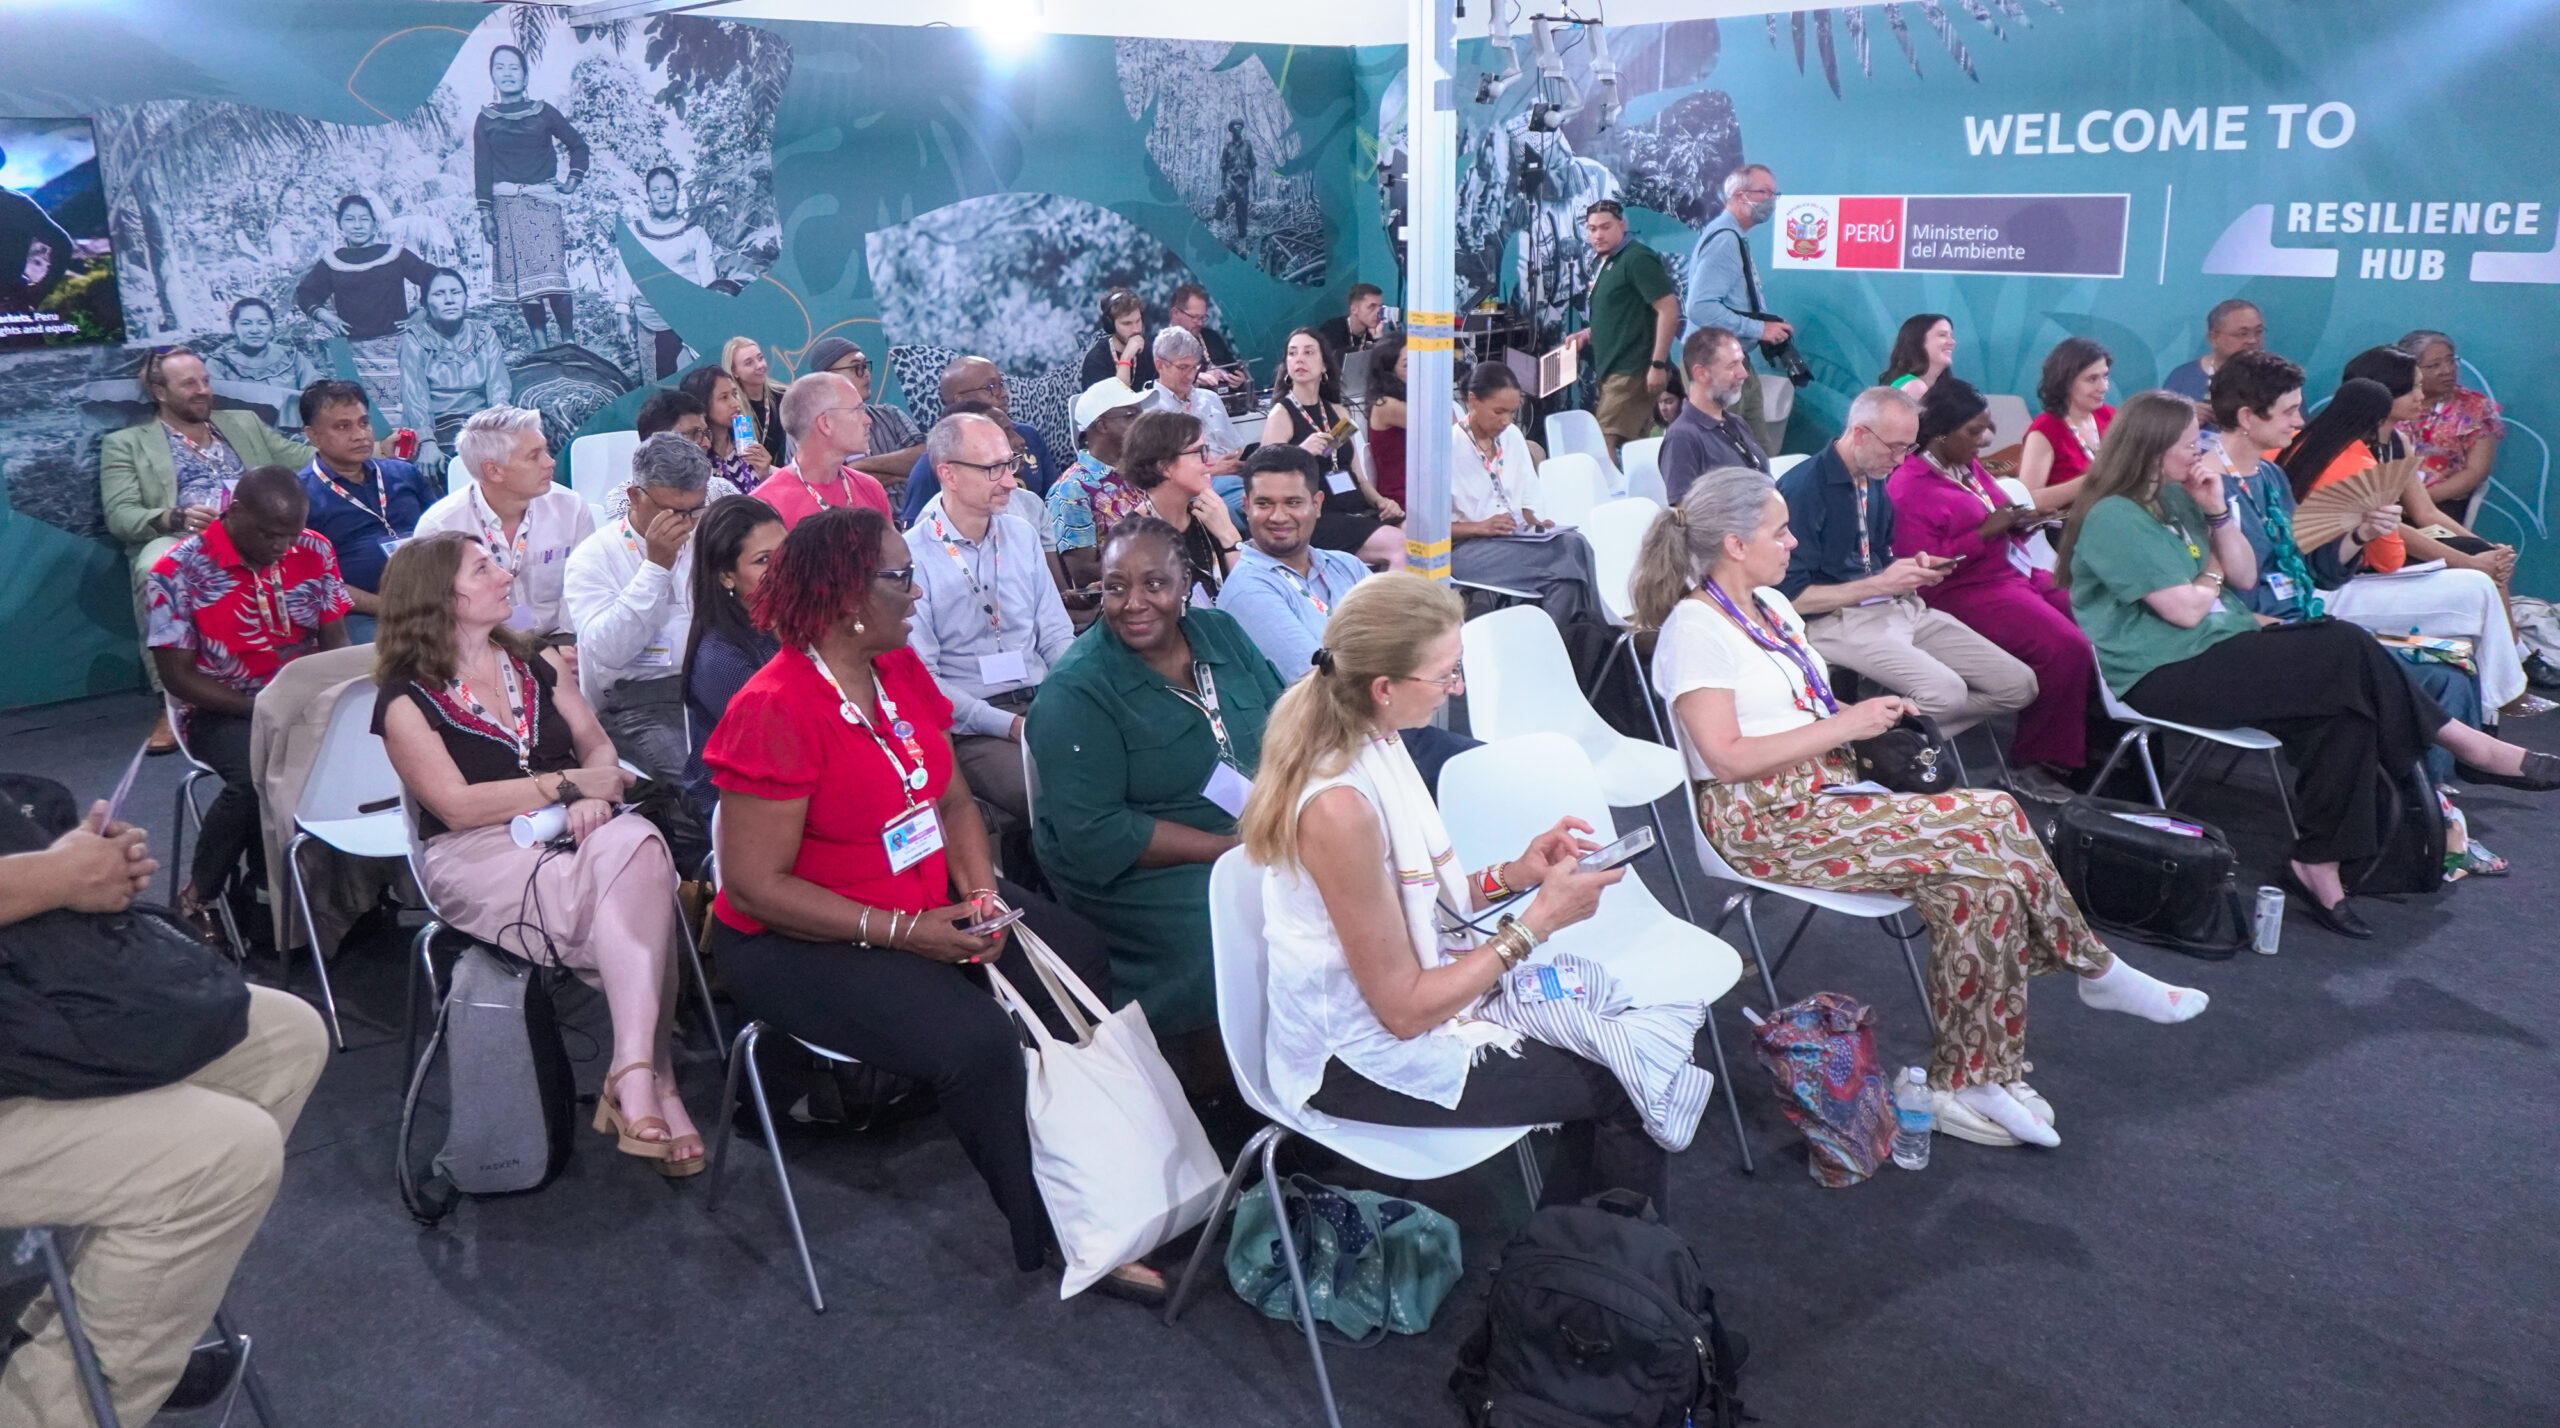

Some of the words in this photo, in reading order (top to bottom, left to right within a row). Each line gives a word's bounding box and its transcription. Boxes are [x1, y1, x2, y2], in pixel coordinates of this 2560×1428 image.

[1964, 106, 2250, 157] WELCOME
[2268, 101, 2356, 150] TO
[2287, 202, 2541, 235] RESILIENCE
[1844, 219, 1895, 242] PERÚ
[1911, 223, 1999, 242] Ministerio
[1911, 242, 1936, 259] del
[1940, 244, 2026, 261] Ambiente
[2359, 249, 2446, 281] HUB
[34, 312, 60, 321] Peru
[23, 324, 44, 334] and
